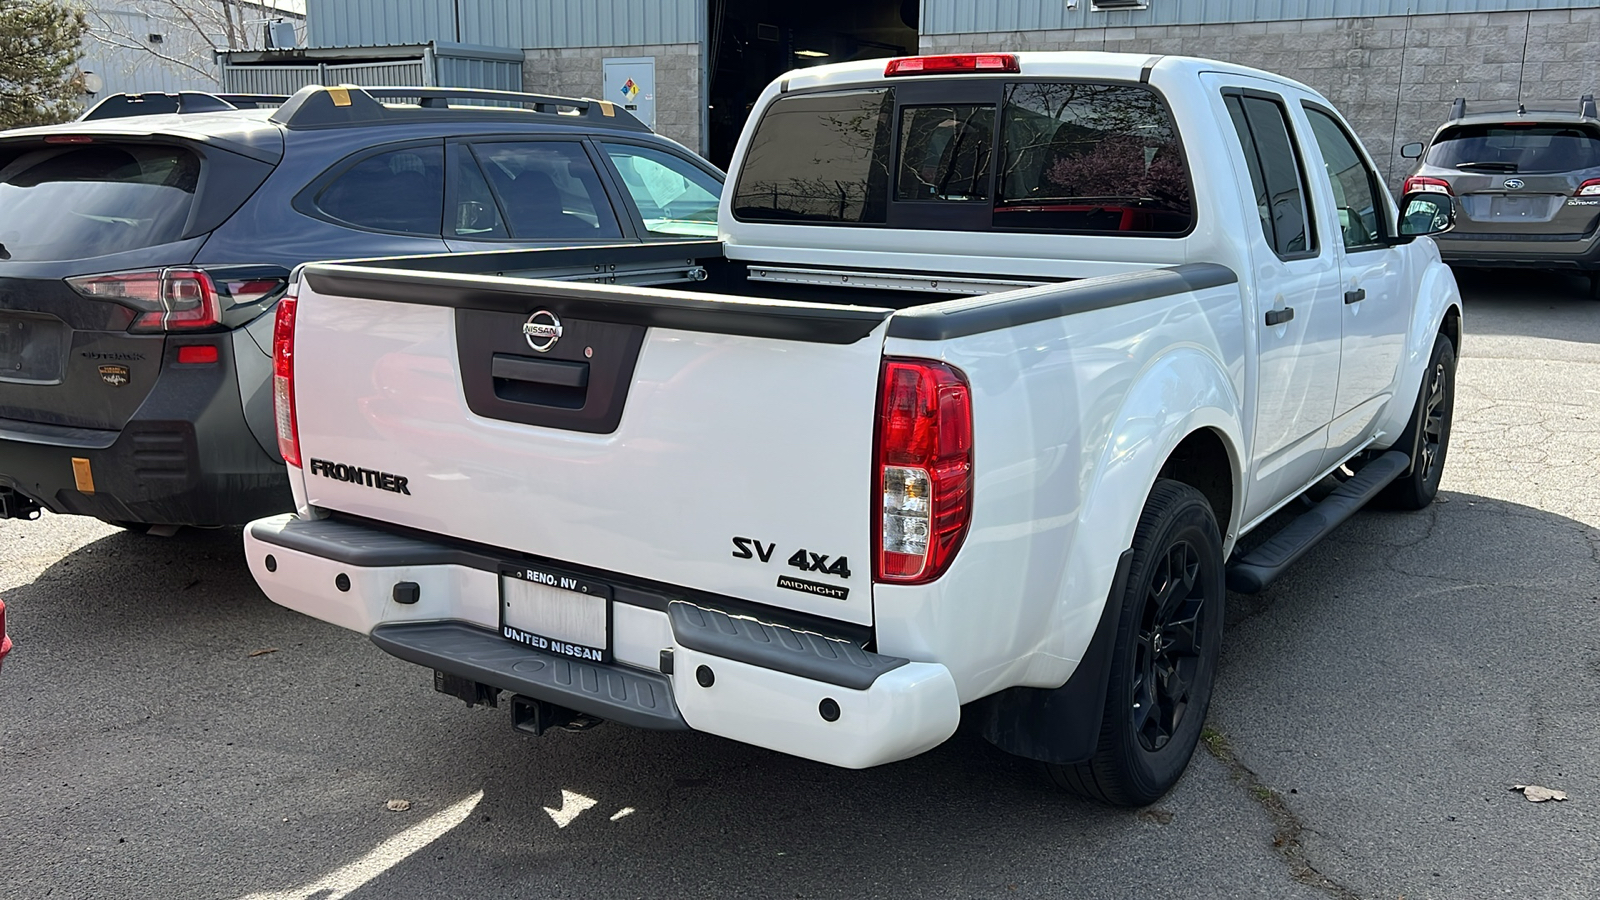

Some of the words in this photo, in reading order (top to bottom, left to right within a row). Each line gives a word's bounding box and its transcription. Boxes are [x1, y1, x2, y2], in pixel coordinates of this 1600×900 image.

[525, 325, 557, 335] NISSAN
[310, 457, 411, 496] FRONTIER
[732, 536, 776, 563] SV
[526, 569, 558, 586] RENO,
[560, 577, 577, 590] NV
[780, 579, 844, 597] MIDNIGHT
[504, 626, 548, 649] UNITED
[551, 641, 602, 661] NISSAN
